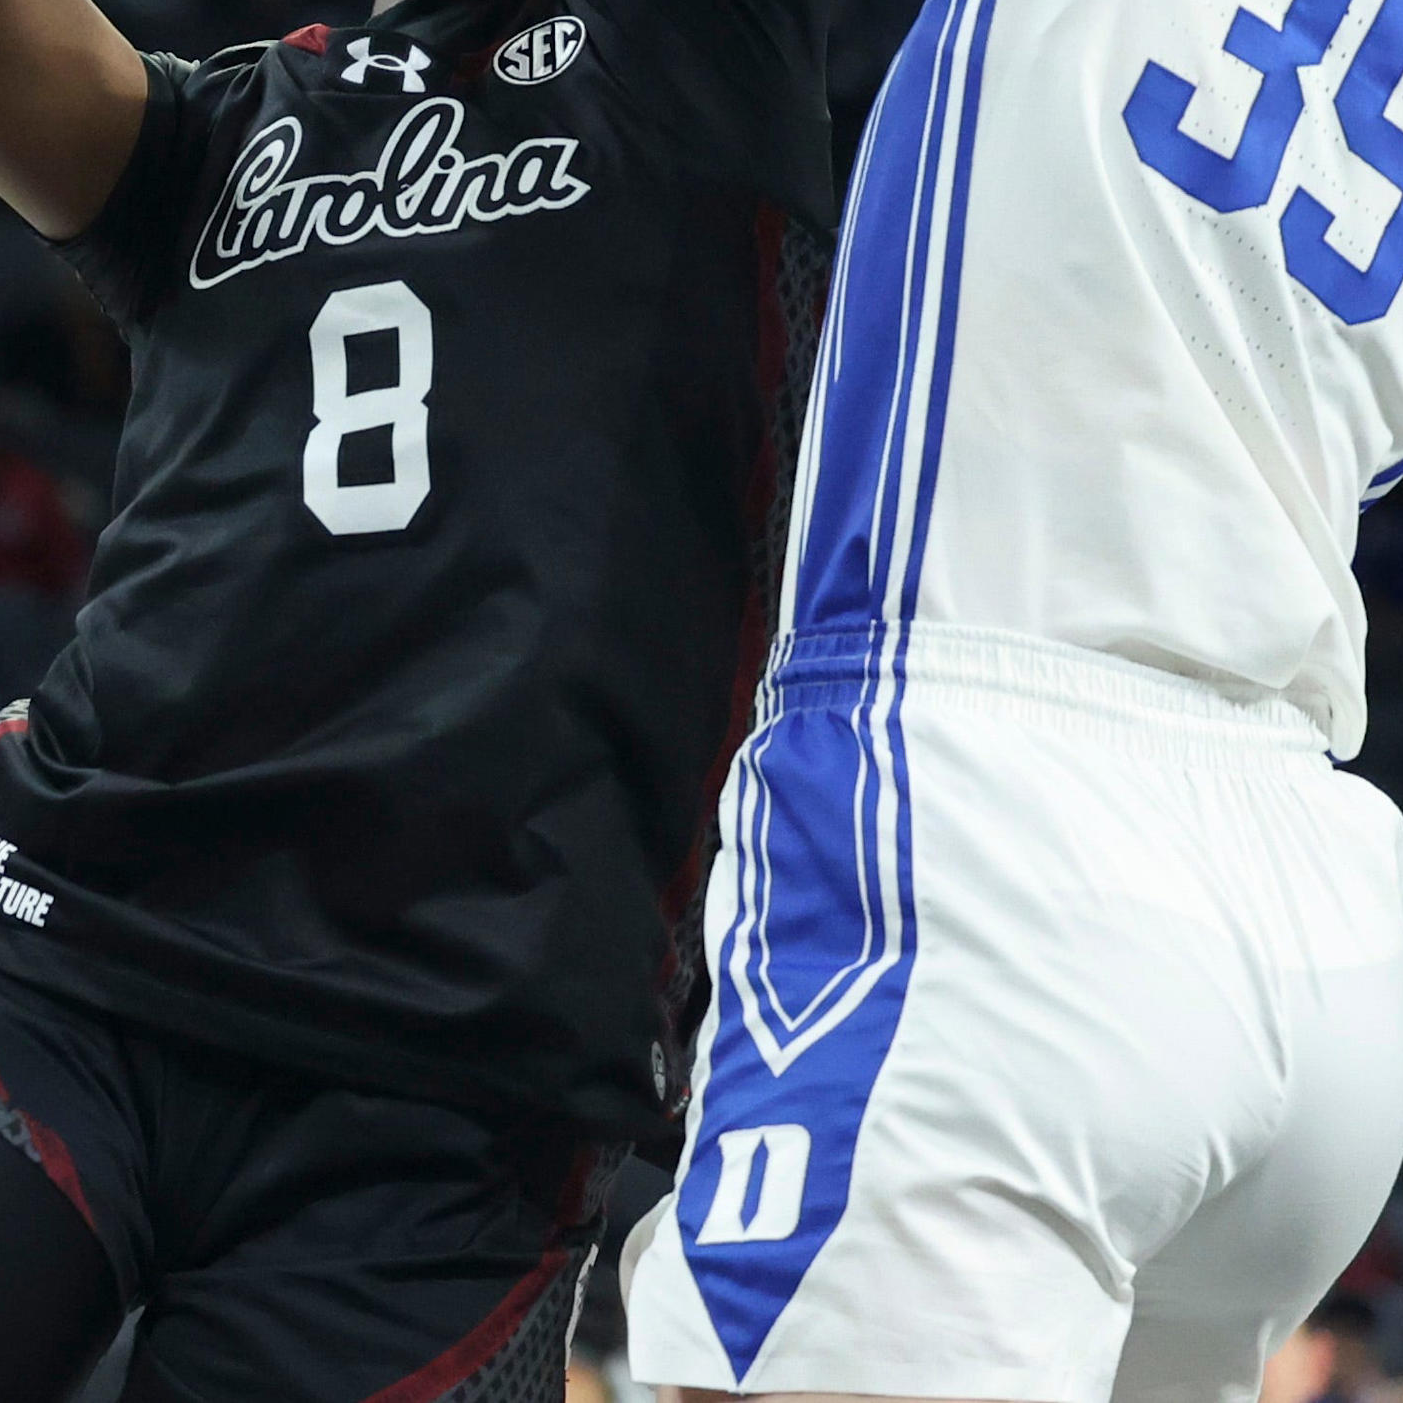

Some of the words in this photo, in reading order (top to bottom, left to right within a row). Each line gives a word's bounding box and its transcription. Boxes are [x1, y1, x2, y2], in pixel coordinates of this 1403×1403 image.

[503, 21, 578, 78] SEC
[189, 96, 591, 290] Carolina
[303, 280, 433, 536] 8
[695, 1123, 811, 1245] D
